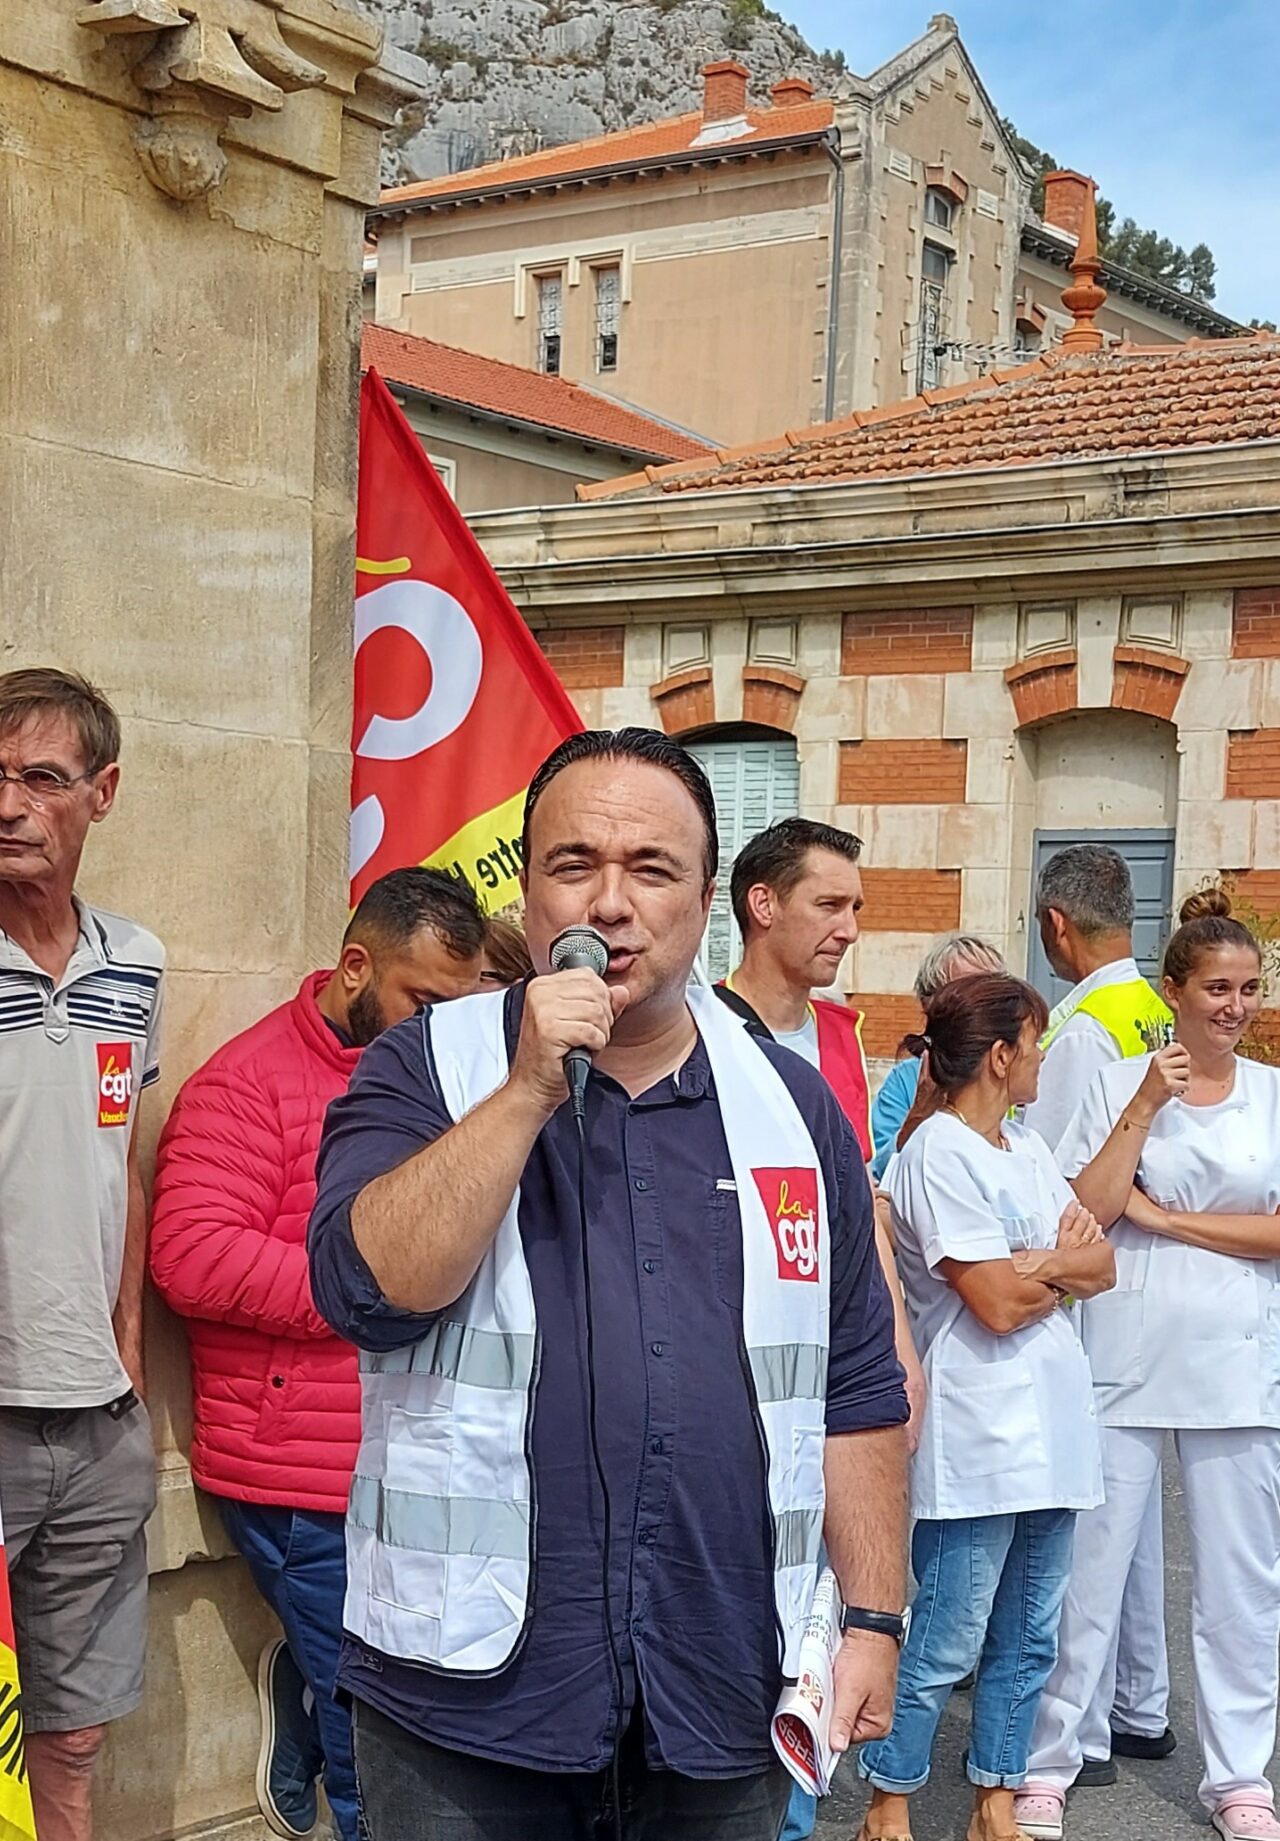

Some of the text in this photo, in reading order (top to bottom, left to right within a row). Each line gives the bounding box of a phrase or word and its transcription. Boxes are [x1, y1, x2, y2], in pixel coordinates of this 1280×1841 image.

[101, 1067, 132, 1103] cgt
[776, 1180, 810, 1218] la
[777, 1209, 819, 1276] cgt
